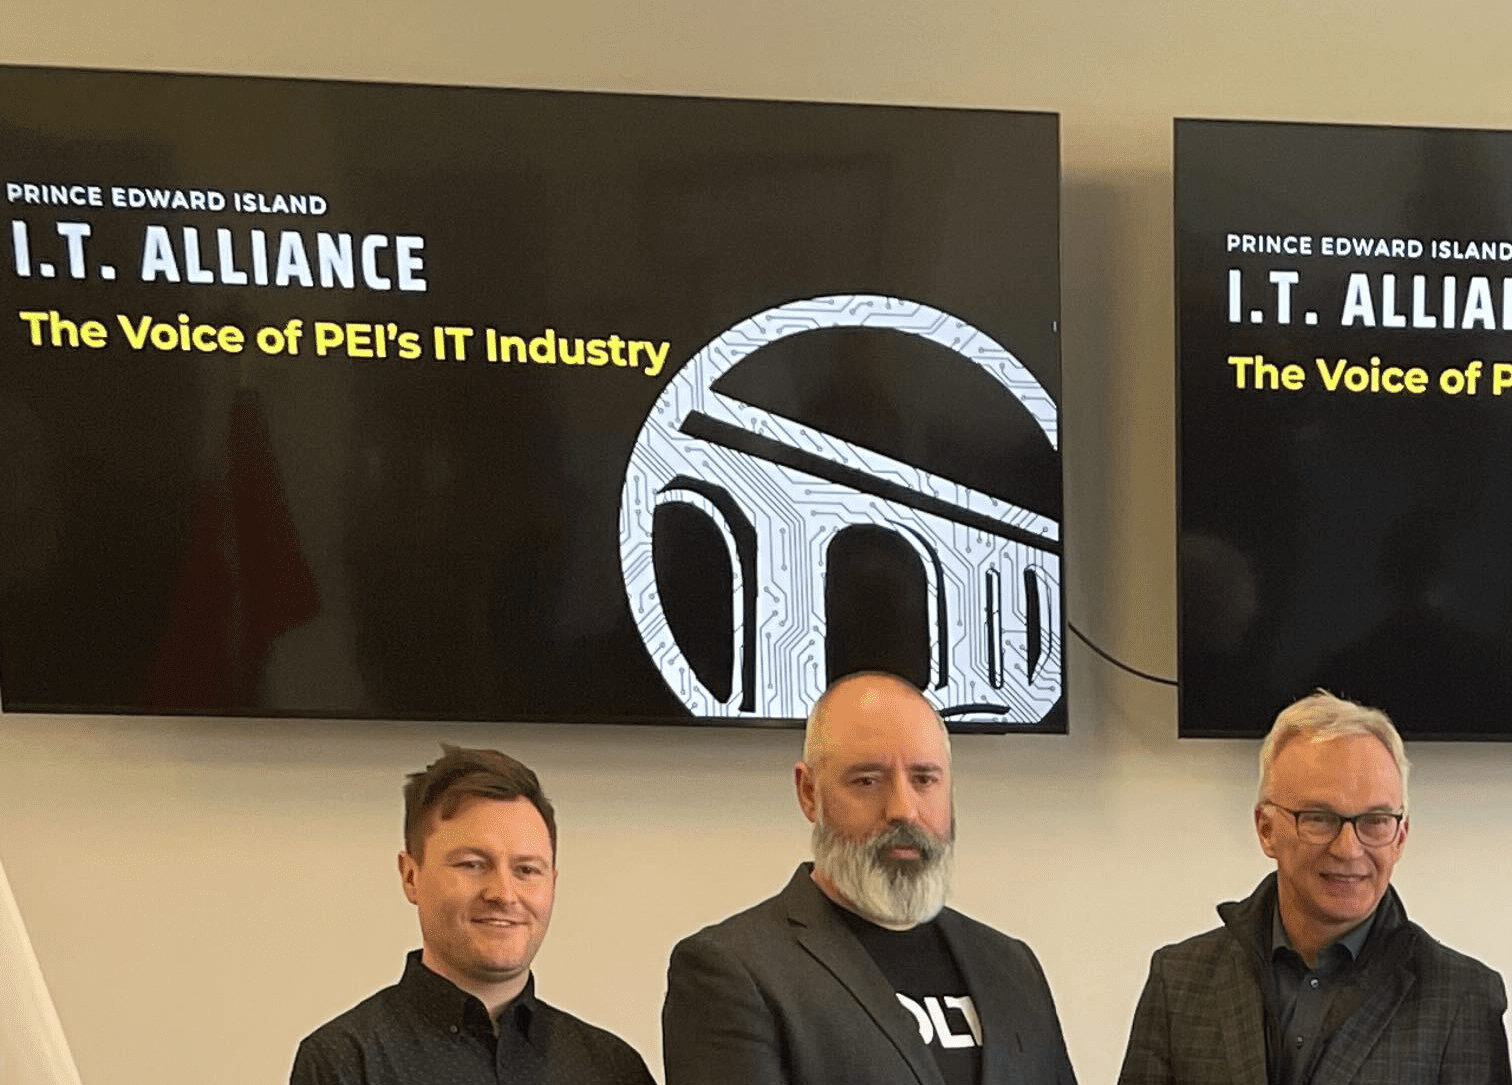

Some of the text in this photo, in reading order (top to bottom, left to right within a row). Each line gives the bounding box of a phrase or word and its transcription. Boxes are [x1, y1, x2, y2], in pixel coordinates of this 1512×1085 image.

[6, 182, 327, 215] PRINCE EDWARD ISLAND
[12, 220, 427, 292] I.T. ALLIANCE
[1227, 233, 1313, 255] PRINCE
[1321, 236, 1424, 259] EDWARD
[1228, 269, 1318, 325] I.T.
[18, 310, 671, 377] The Voice of PEI’s IT Industry
[1227, 354, 1306, 391] The
[1315, 356, 1429, 395] Voice
[1439, 360, 1483, 396] of
